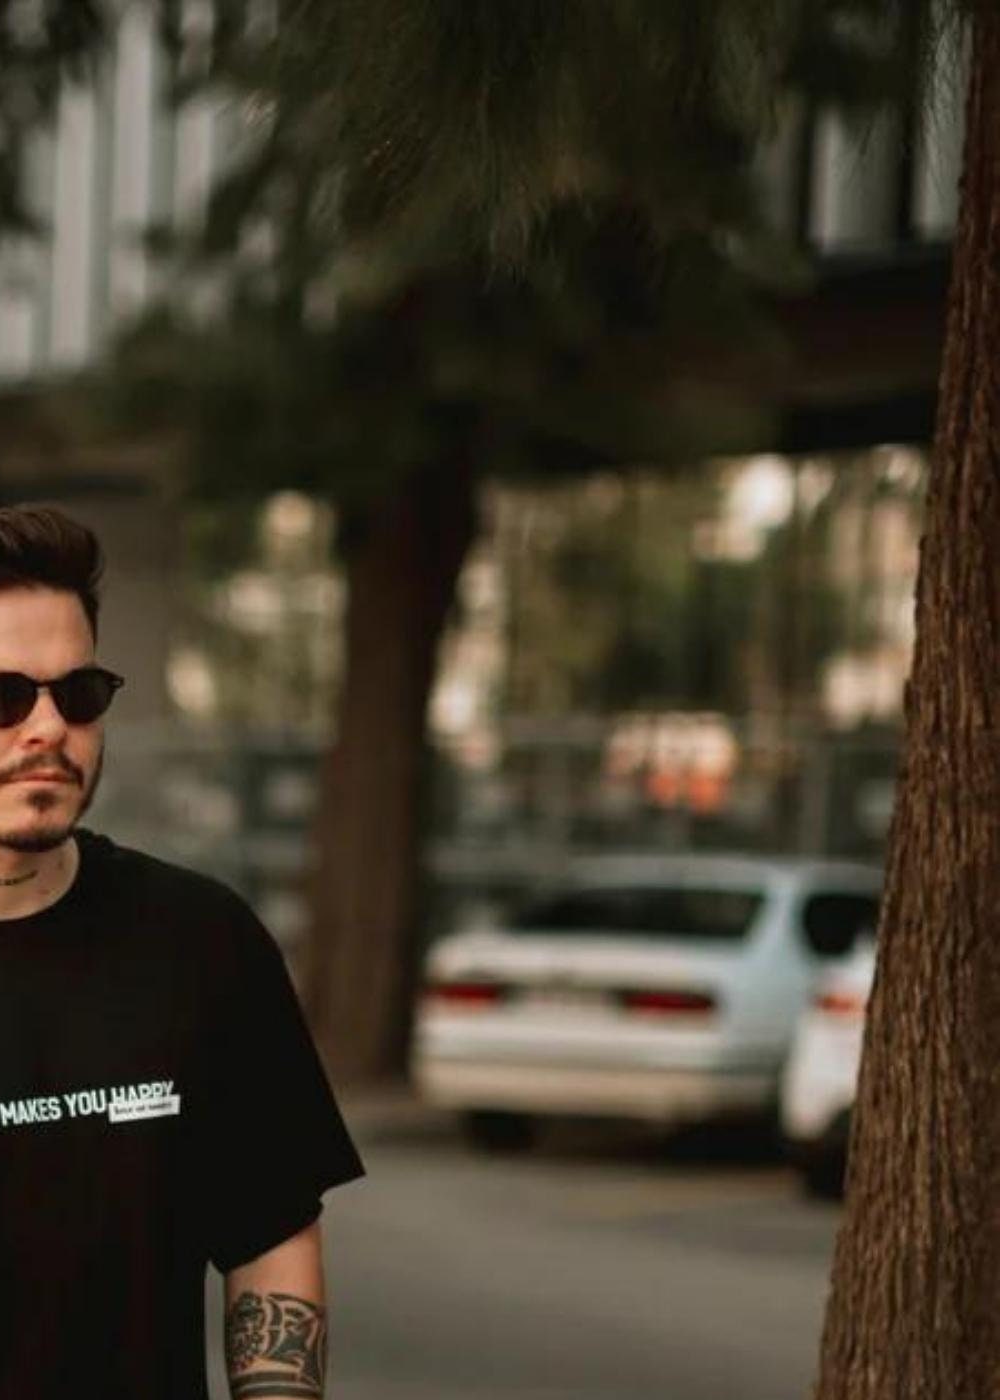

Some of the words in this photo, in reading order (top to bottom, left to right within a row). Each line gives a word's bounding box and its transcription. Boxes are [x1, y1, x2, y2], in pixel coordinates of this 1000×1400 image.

[0, 1097, 62, 1126] MAKES
[63, 1089, 106, 1117] YOU
[110, 1081, 174, 1104] HAPPY
